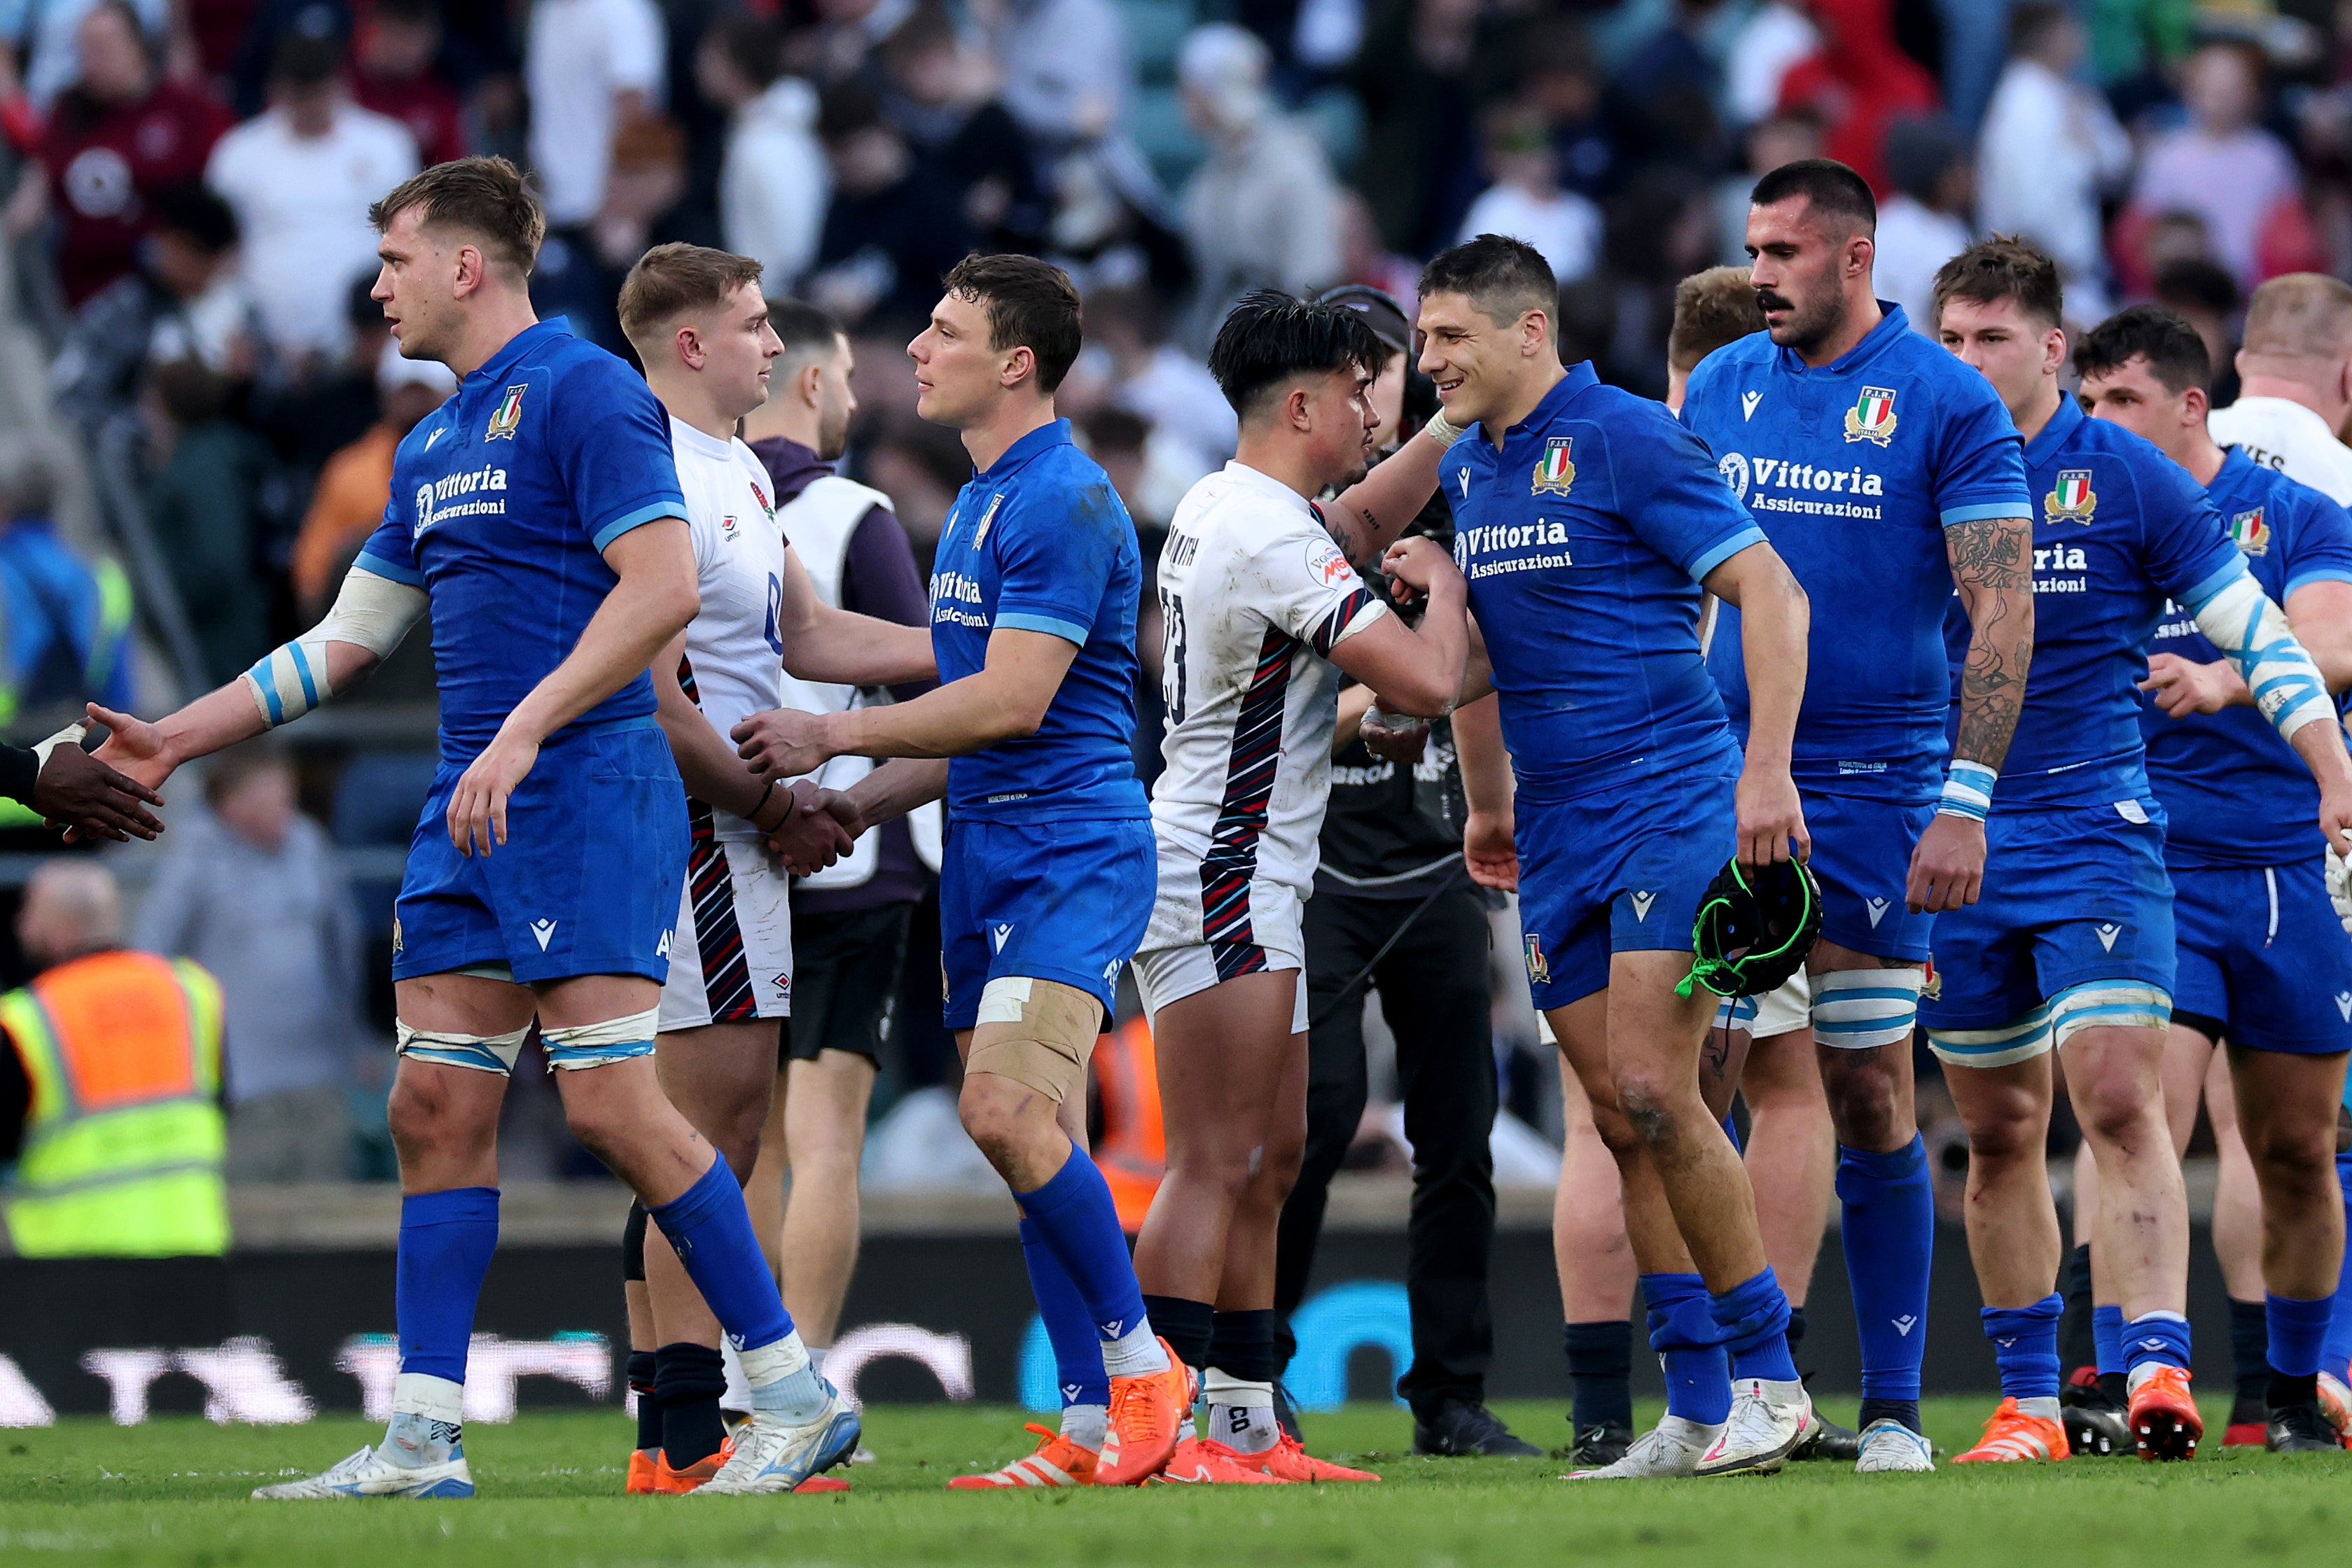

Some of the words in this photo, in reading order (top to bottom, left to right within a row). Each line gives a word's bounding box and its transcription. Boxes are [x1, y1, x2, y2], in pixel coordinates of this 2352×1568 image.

[1865, 388, 1891, 400] F.I.R.
[434, 463, 508, 504] Vittoria
[1752, 457, 1883, 496] Vittoria
[423, 498, 506, 527] Assicurazioni
[1751, 493, 1881, 520] Assicurazioni
[1468, 517, 1568, 556] Vittoria
[1470, 551, 1573, 580] Assicurazioni
